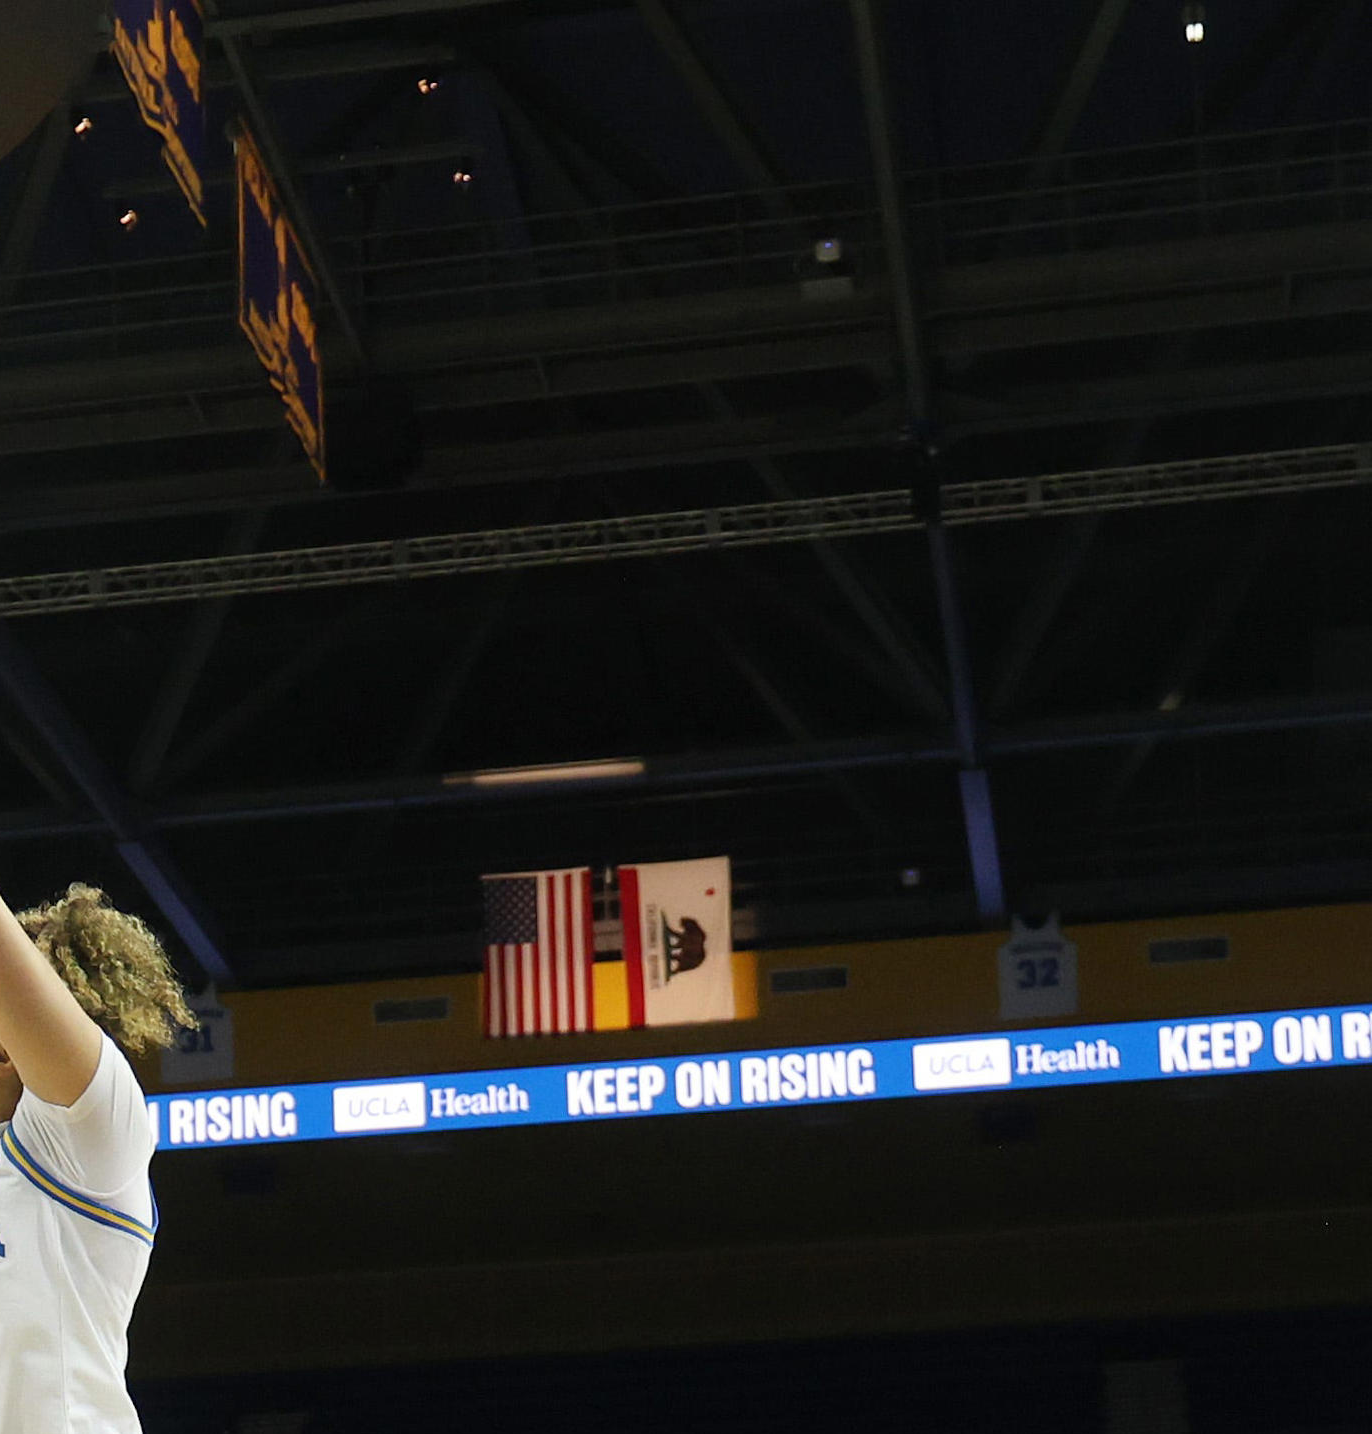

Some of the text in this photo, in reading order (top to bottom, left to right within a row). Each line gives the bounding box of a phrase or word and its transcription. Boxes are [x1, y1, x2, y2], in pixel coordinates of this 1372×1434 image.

[1017, 957, 1060, 989] 32
[928, 1039, 1121, 1077] UCLA Health
[1158, 1010, 1372, 1073] KEEP ON R
[347, 1083, 529, 1119] UCLA Health
[565, 1049, 876, 1117] KEEP ON RISING
[169, 1092, 297, 1144] RISING
